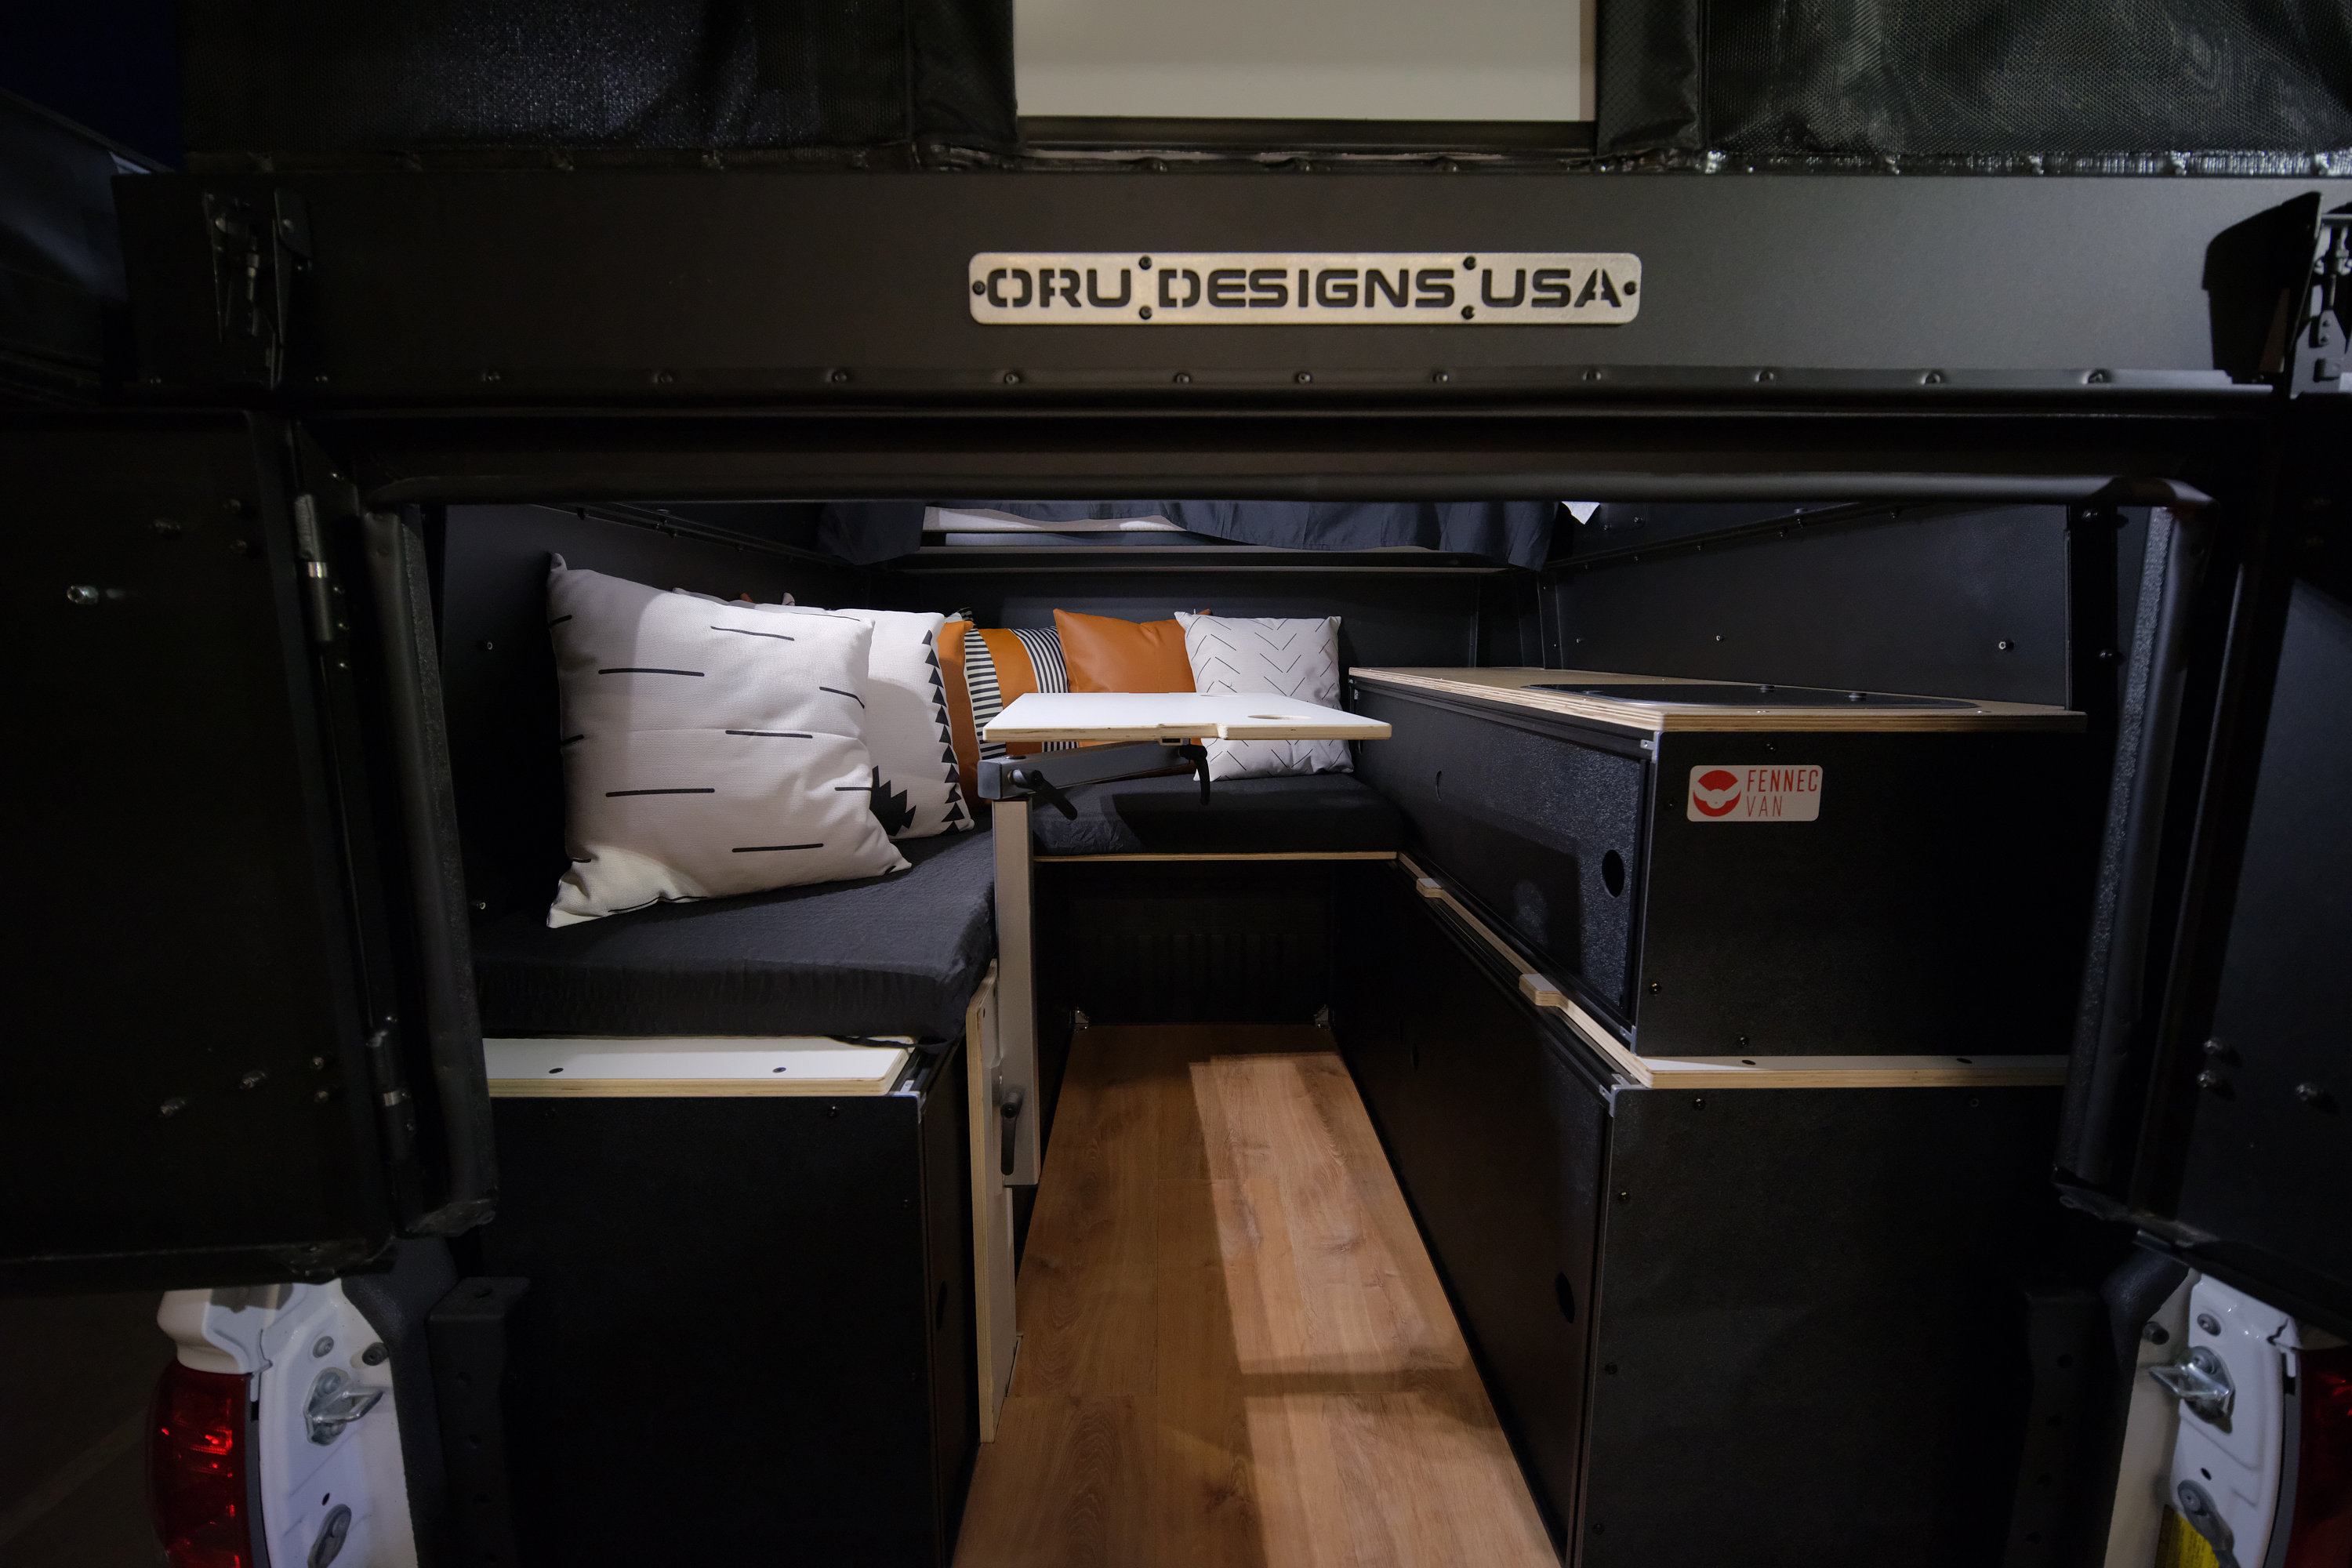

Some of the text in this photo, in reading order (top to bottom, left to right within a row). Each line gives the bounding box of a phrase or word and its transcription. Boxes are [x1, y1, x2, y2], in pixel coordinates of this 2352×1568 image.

[986, 268, 1622, 308] ORU DESIGNS USA
[1747, 769, 1819, 792] FENNEC
[1747, 796, 1783, 817] VAN
